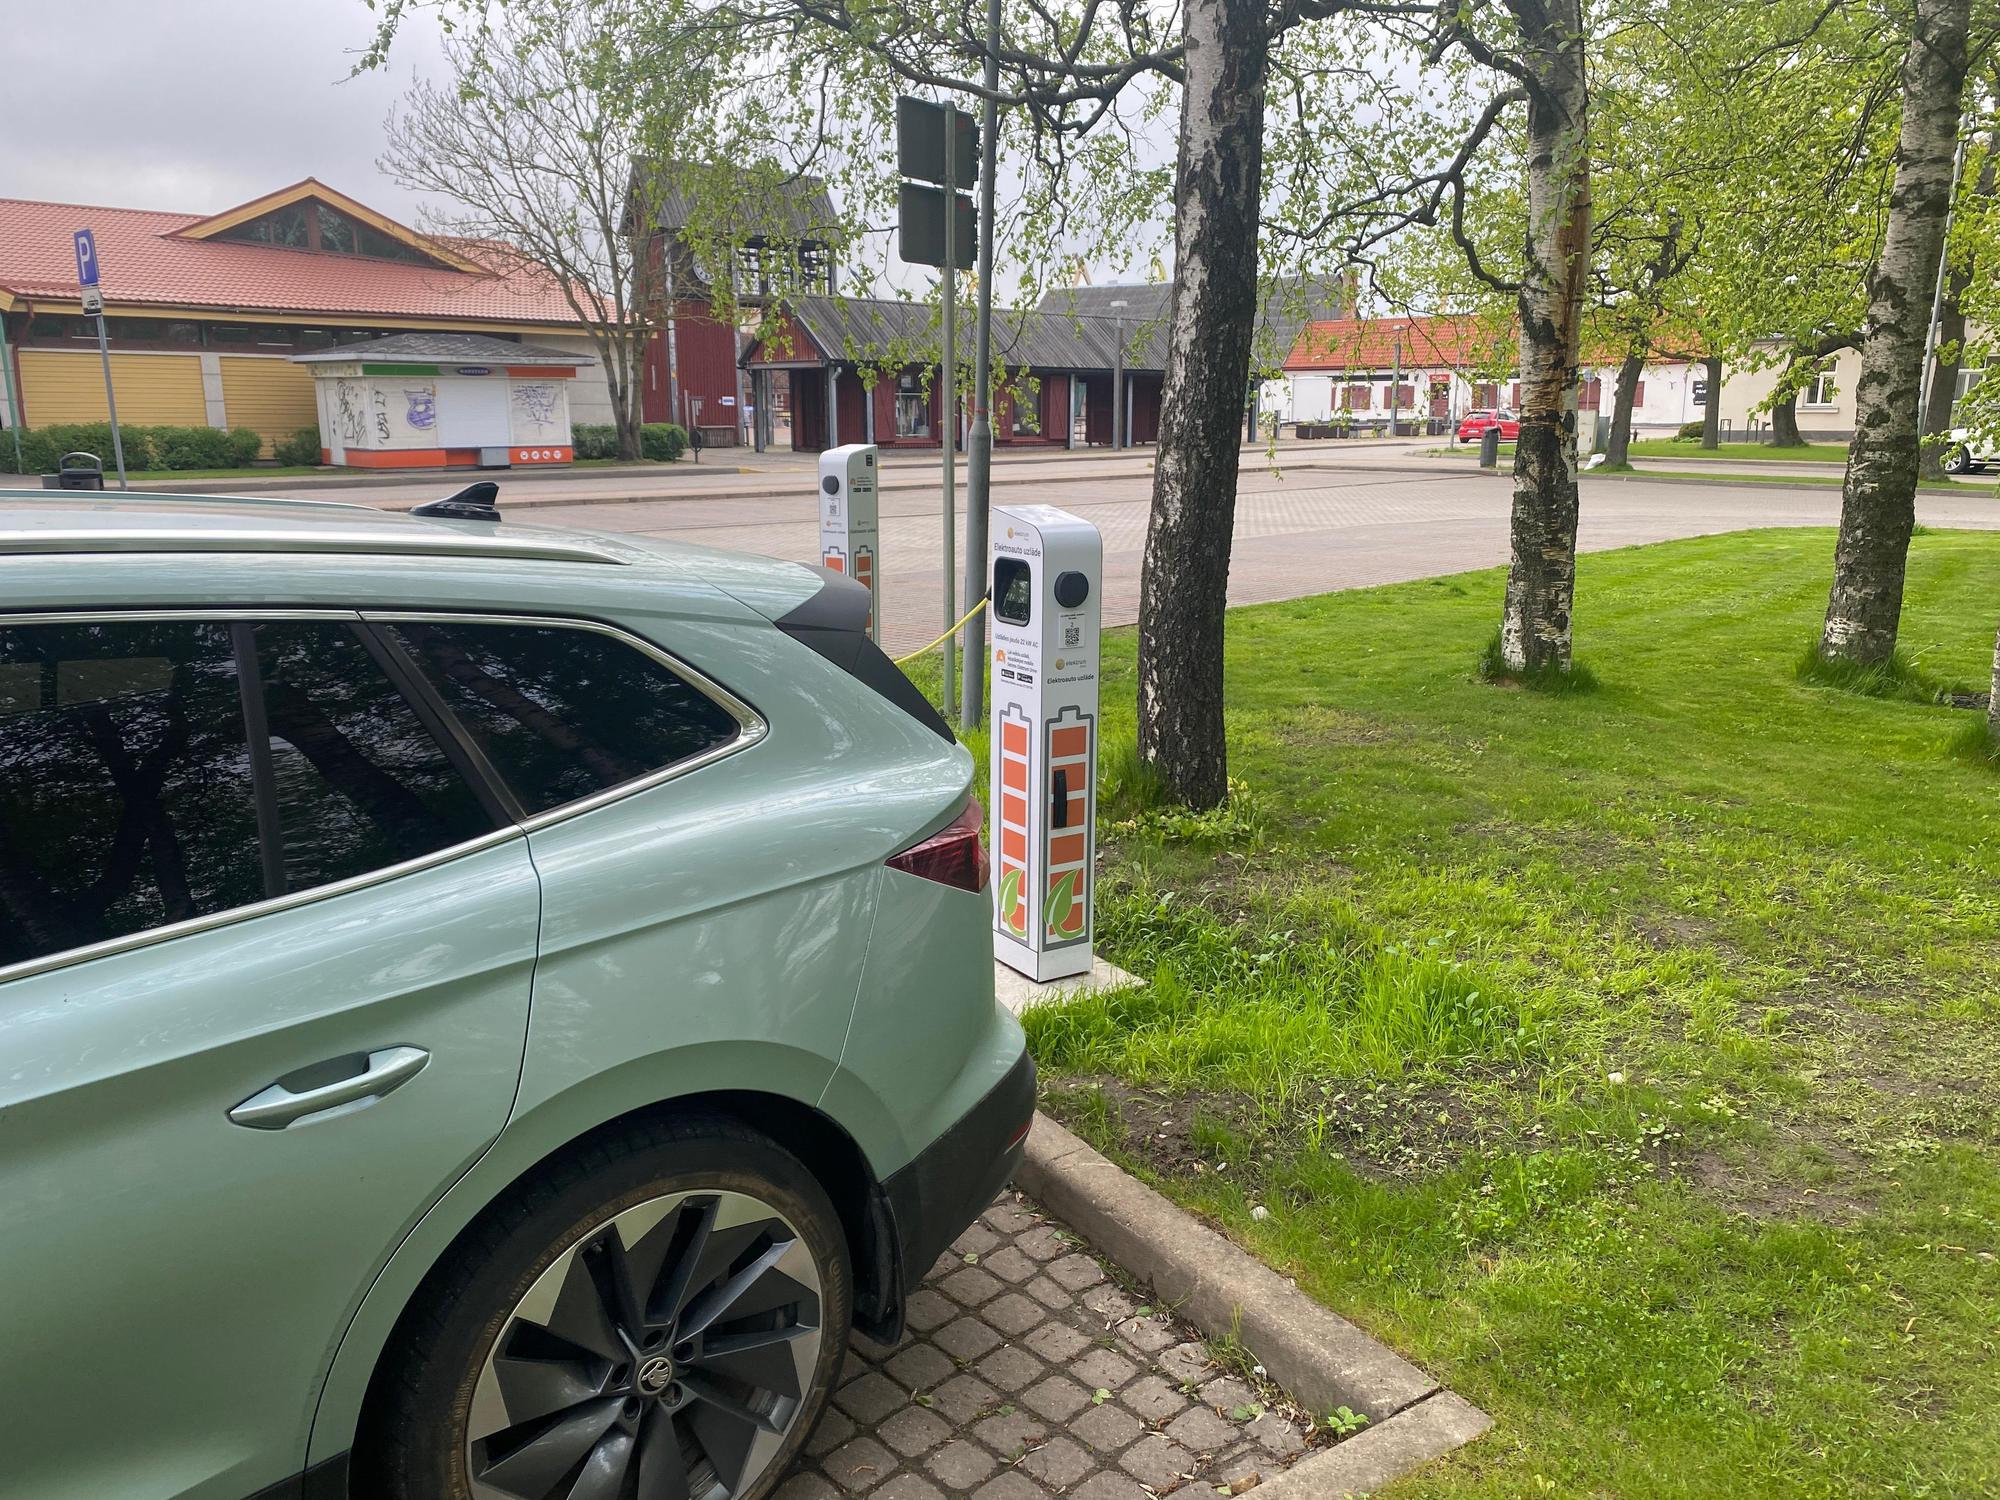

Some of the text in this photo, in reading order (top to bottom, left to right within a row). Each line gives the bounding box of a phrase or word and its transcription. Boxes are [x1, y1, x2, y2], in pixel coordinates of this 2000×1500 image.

[78, 236, 90, 280] P
[994, 542, 1041, 557] Elektroauto uzlāde
[1047, 676, 1076, 684] Elektroauto
